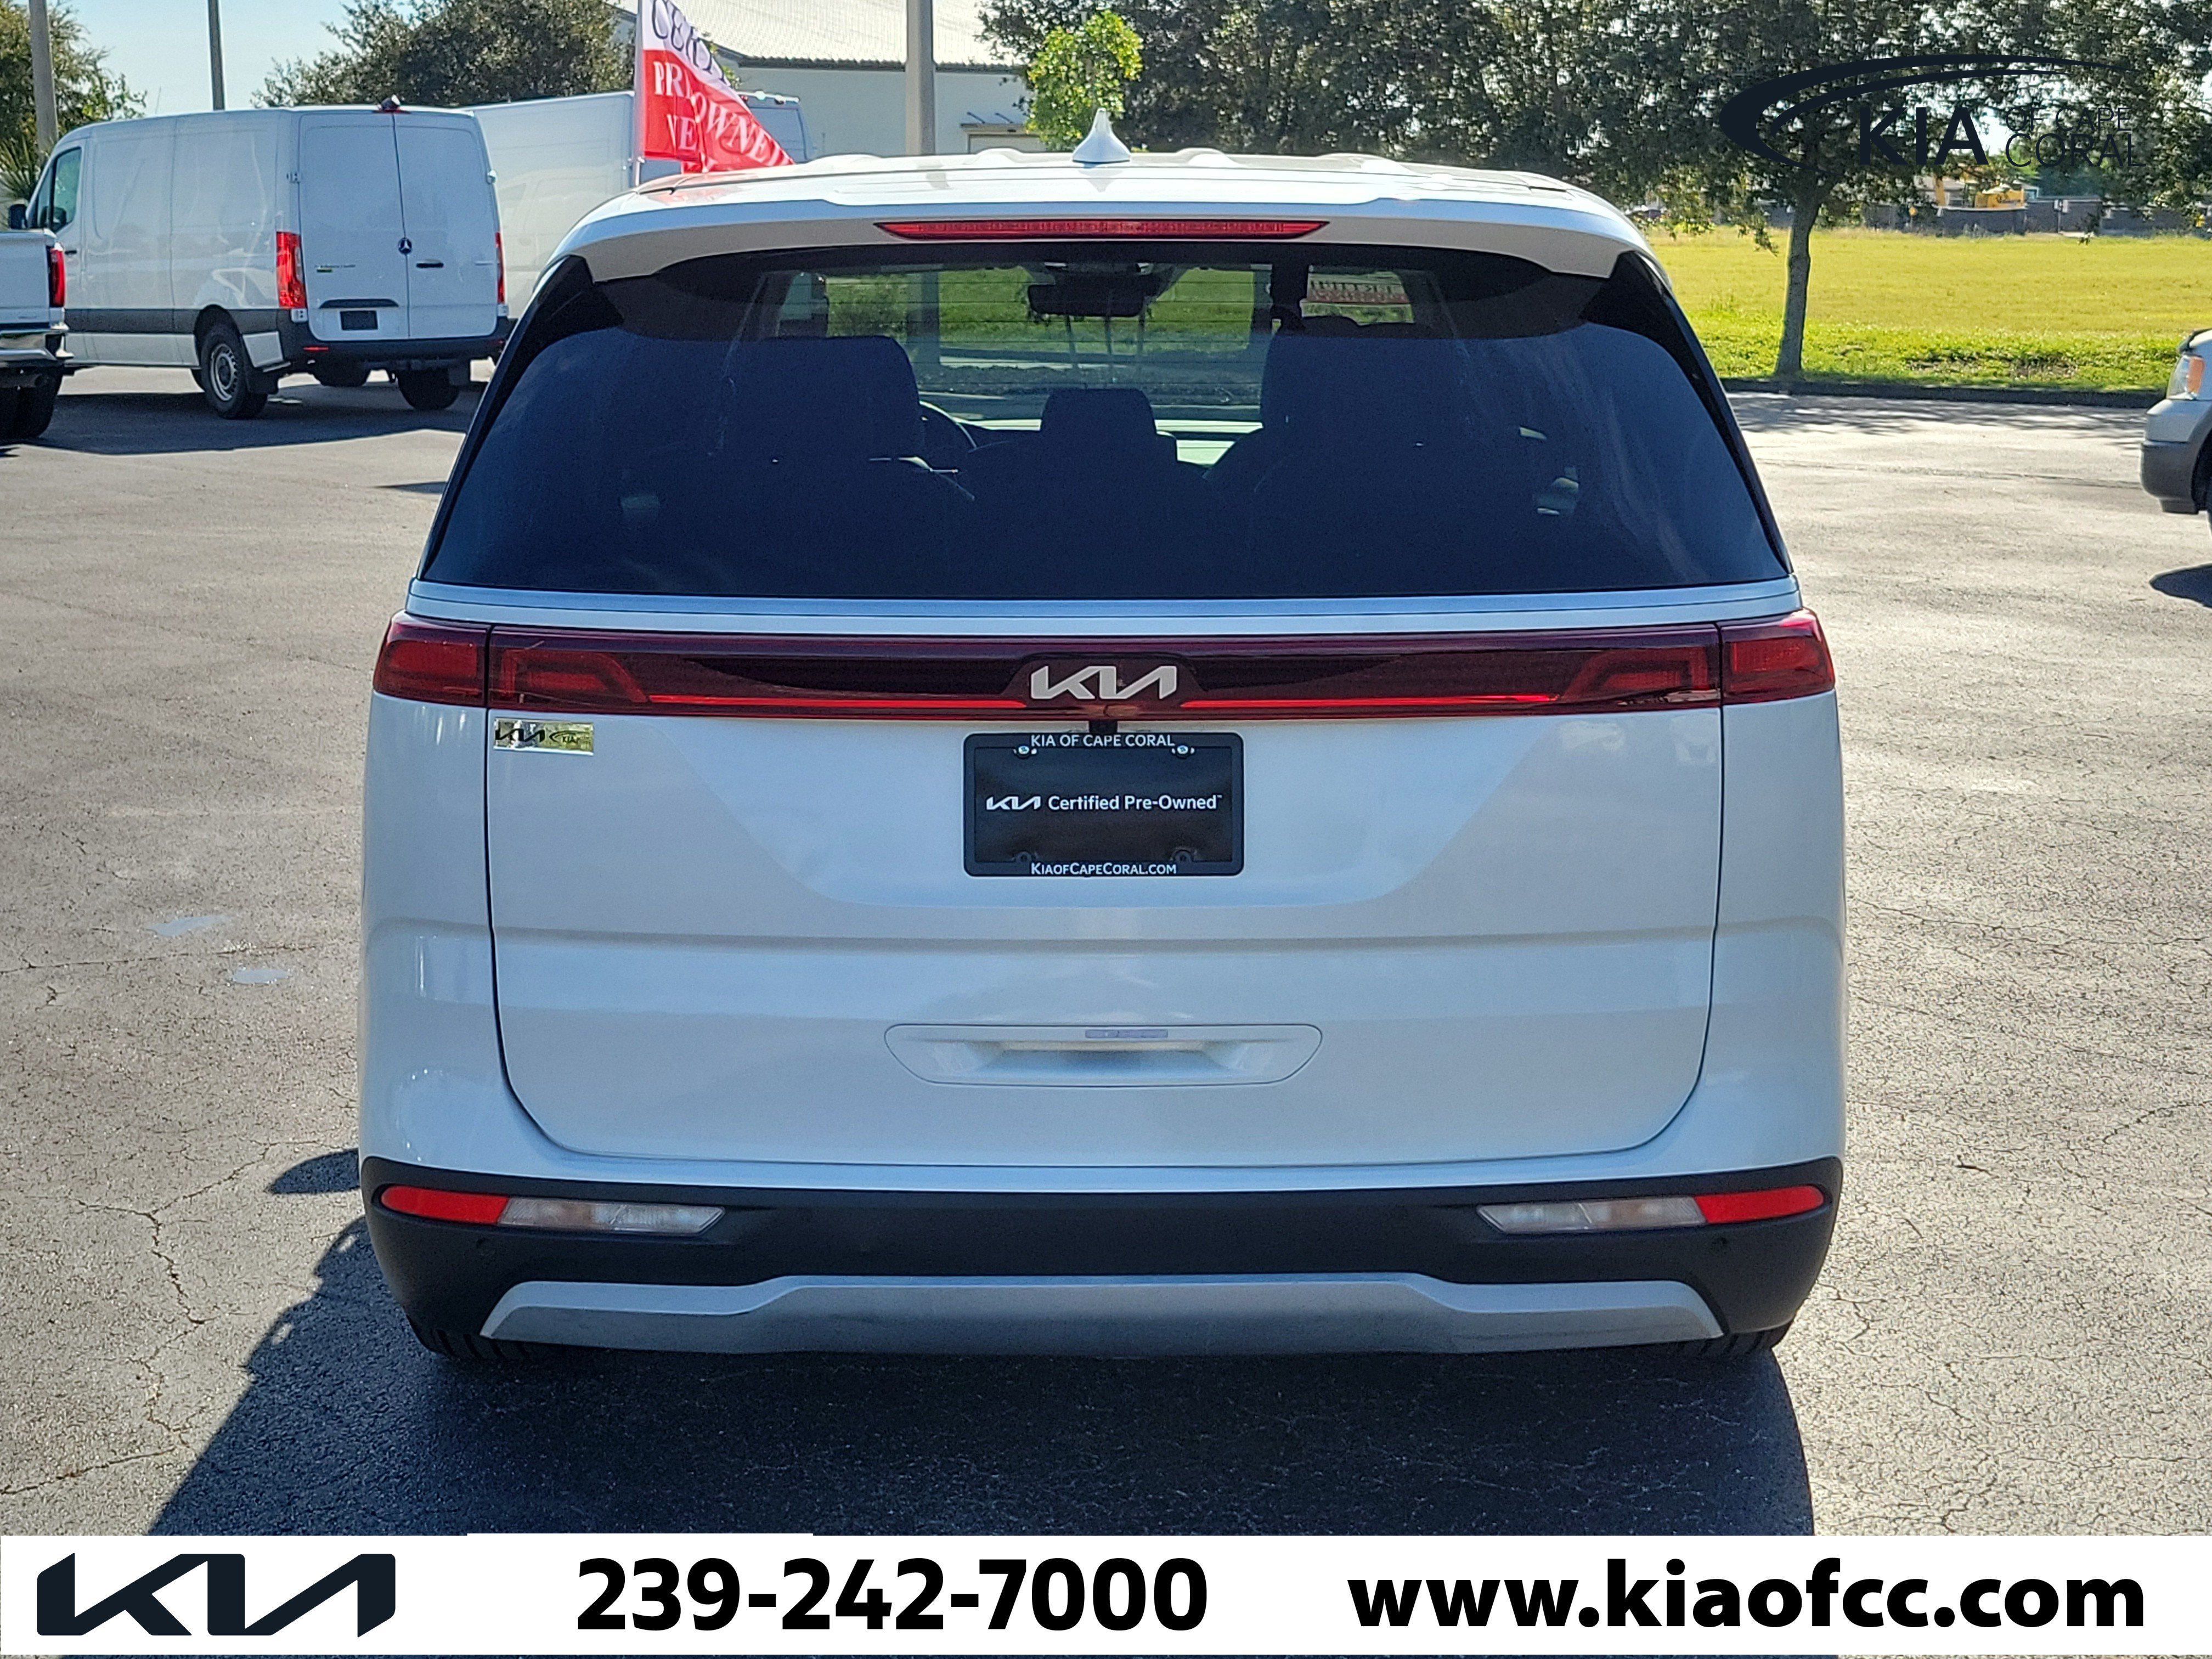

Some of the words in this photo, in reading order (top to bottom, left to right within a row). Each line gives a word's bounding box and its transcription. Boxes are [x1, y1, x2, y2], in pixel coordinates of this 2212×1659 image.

[1031, 734, 1056, 746] KIA
[1059, 734, 1079, 747] OF
[1082, 734, 1121, 747] CAPE
[1125, 734, 1175, 747] CORAL
[1048, 795, 1120, 810] Certified
